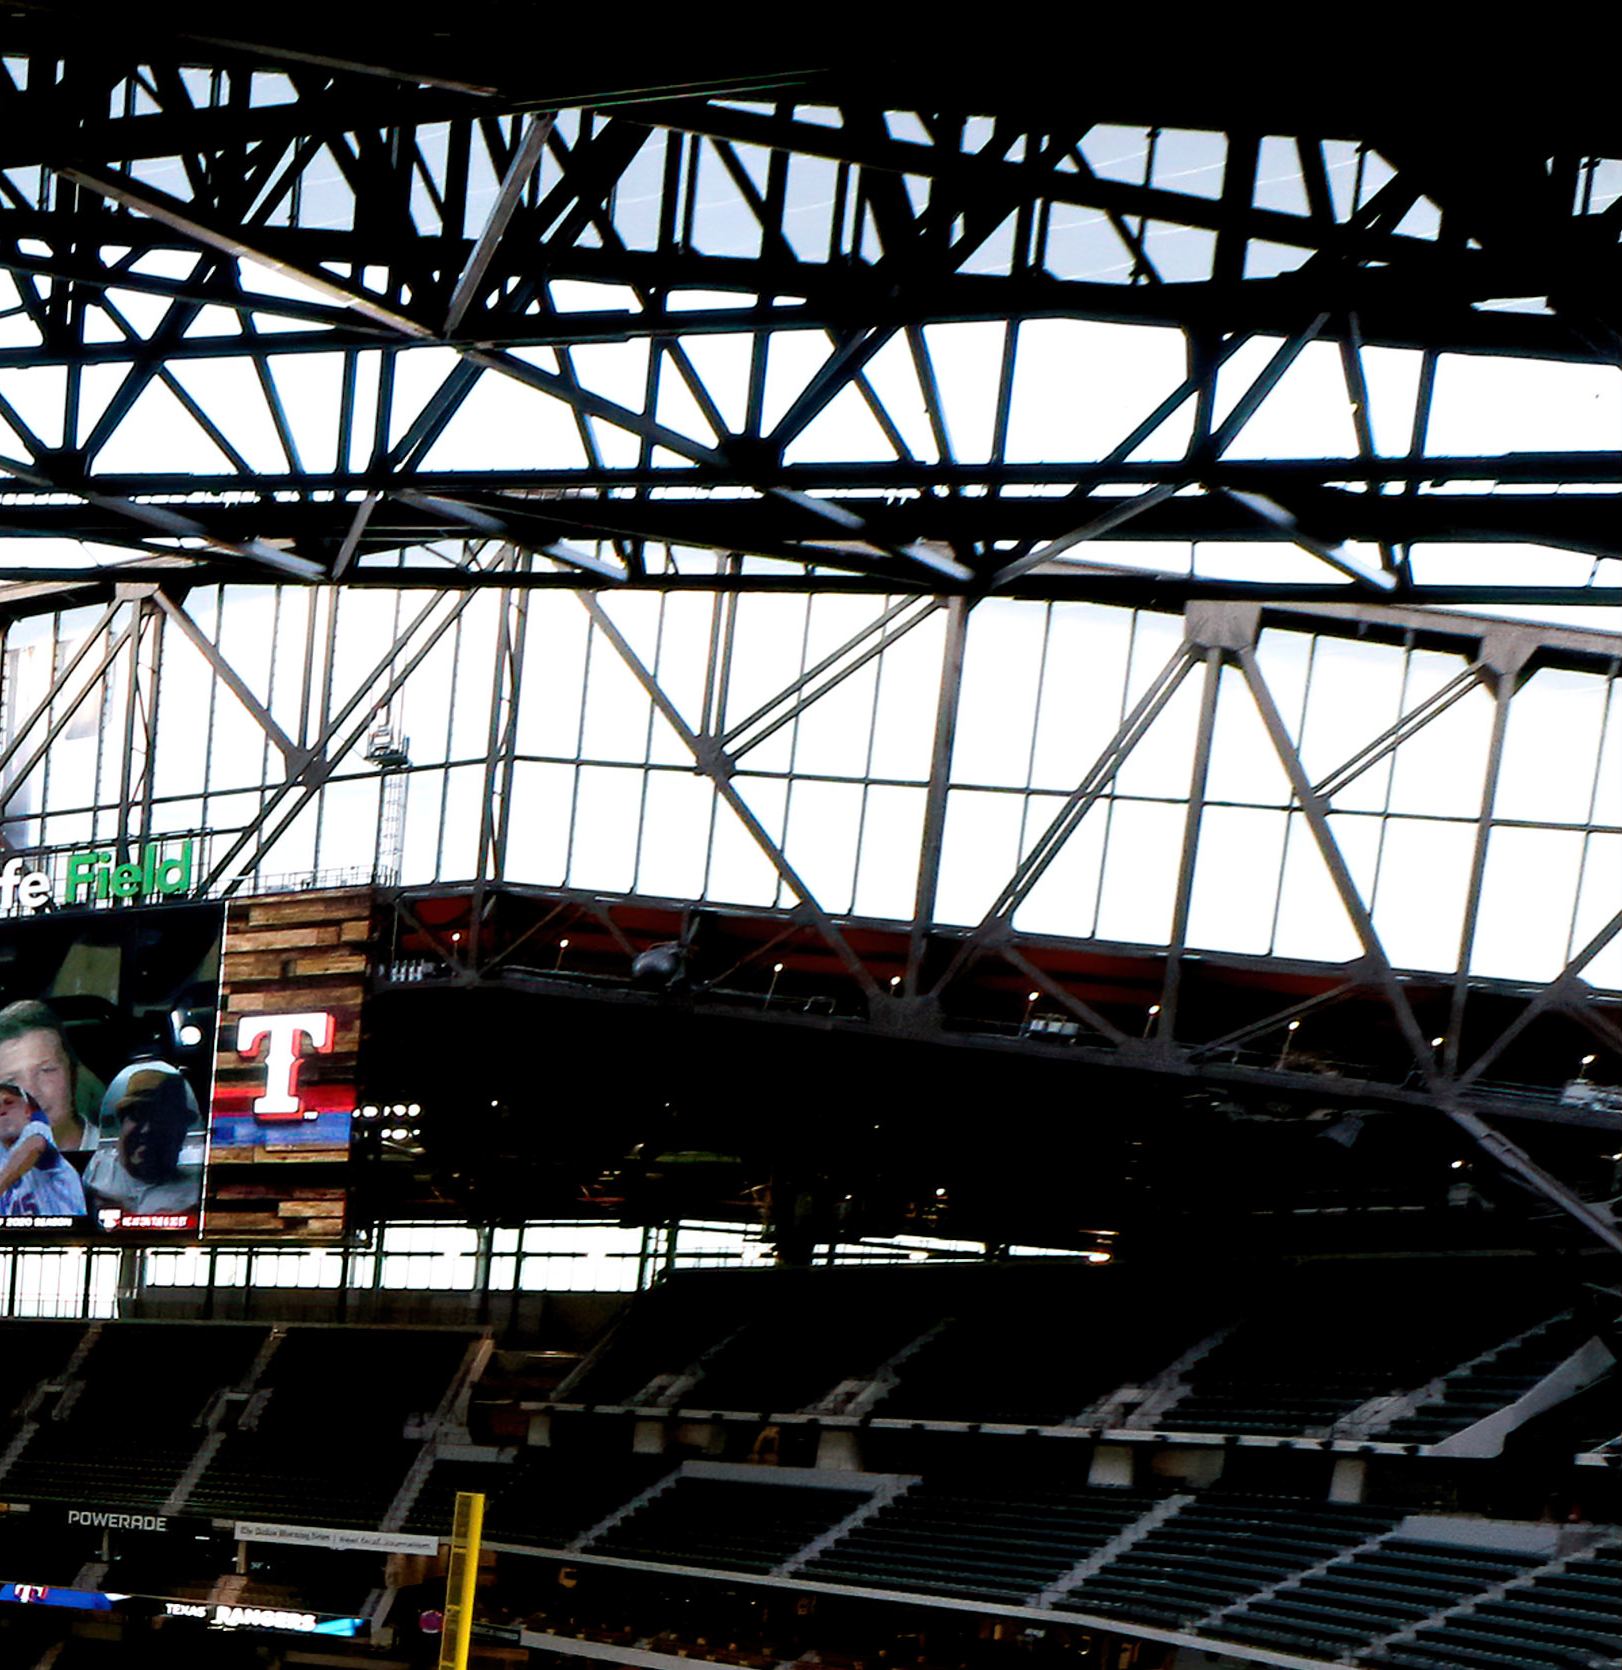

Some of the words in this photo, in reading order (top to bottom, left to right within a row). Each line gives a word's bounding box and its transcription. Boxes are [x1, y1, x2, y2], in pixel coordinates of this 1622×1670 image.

[65, 839, 193, 902] Field
[235, 1011, 336, 1118] T
[67, 1510, 168, 1533] POWERADE
[165, 1602, 206, 1619] TEXAS
[210, 1604, 318, 1633] RANGERS
